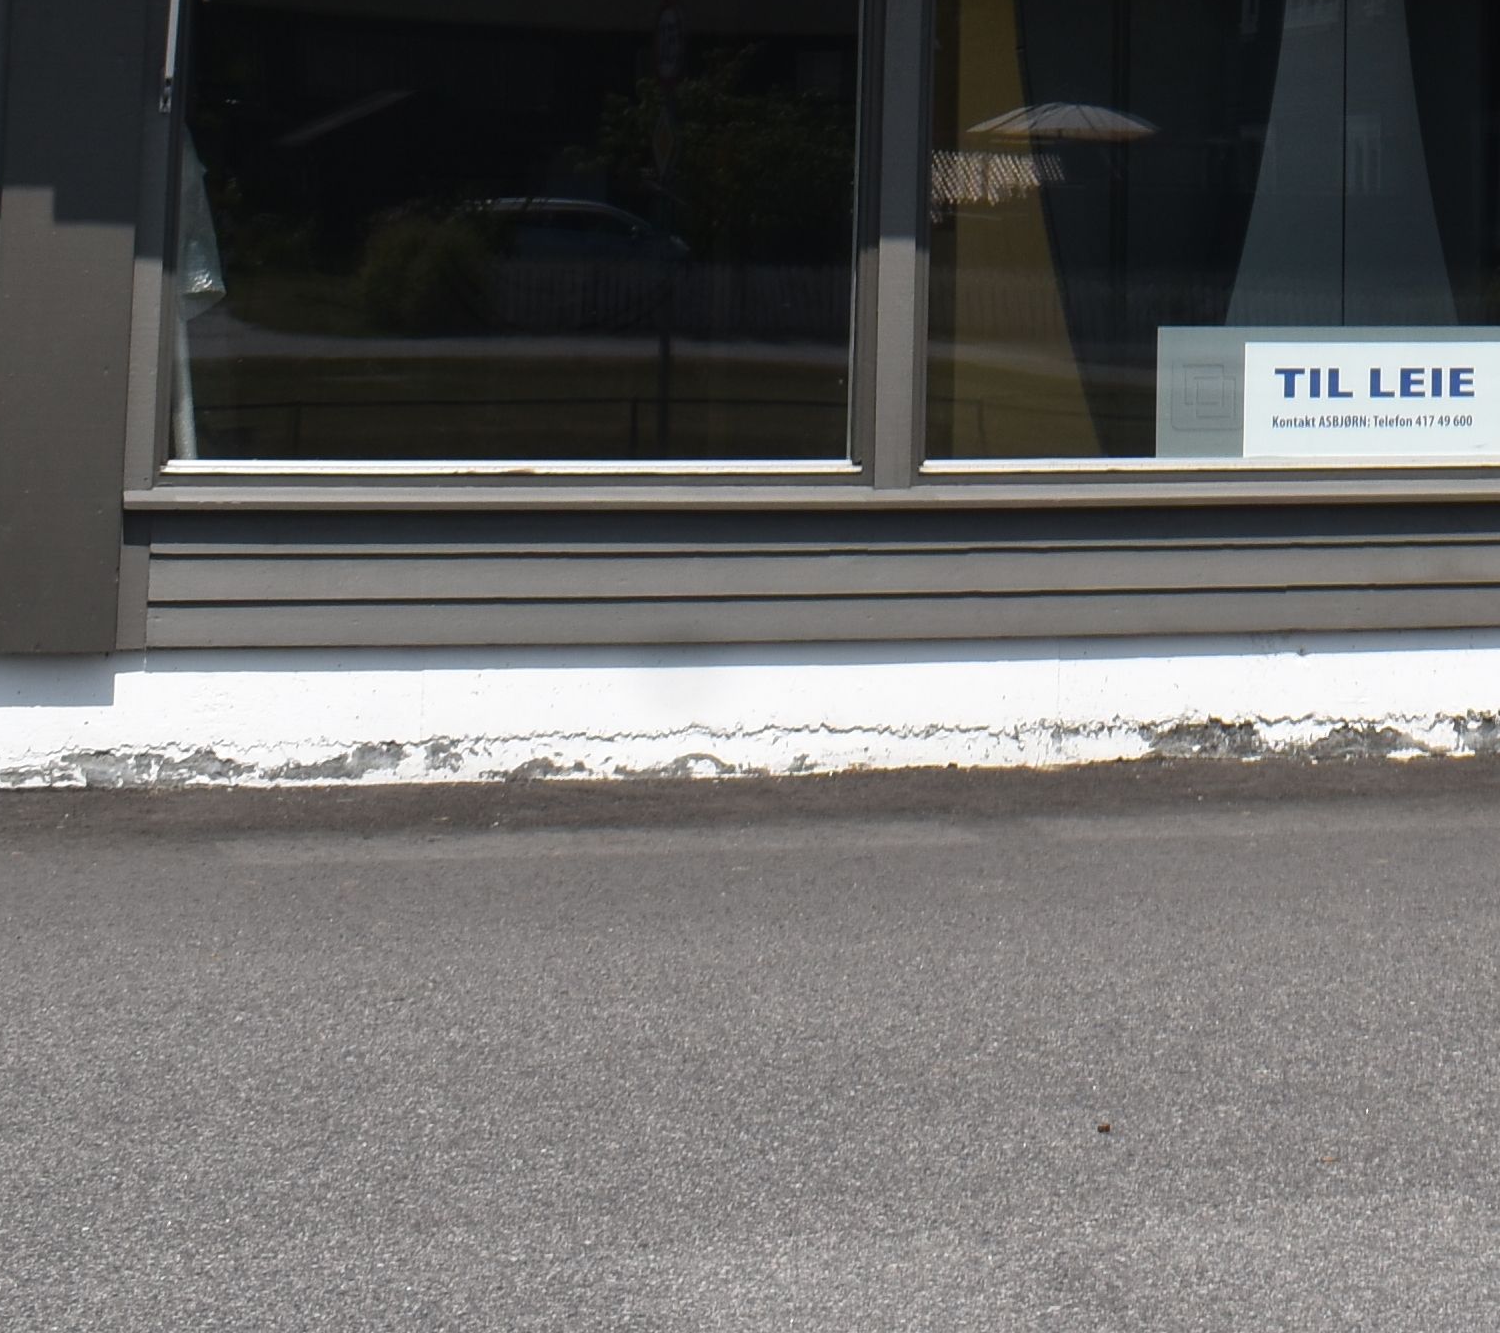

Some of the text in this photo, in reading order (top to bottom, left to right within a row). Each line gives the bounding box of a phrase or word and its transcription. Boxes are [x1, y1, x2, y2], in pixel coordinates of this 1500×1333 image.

[1274, 368, 1353, 398] TIL
[1370, 367, 1475, 398] LEIE
[1272, 414, 1315, 428] Kontakt
[1373, 413, 1413, 428] Telefon
[1415, 414, 1434, 427] 417
[1437, 414, 1451, 427] 49
[1453, 414, 1473, 427] 600
